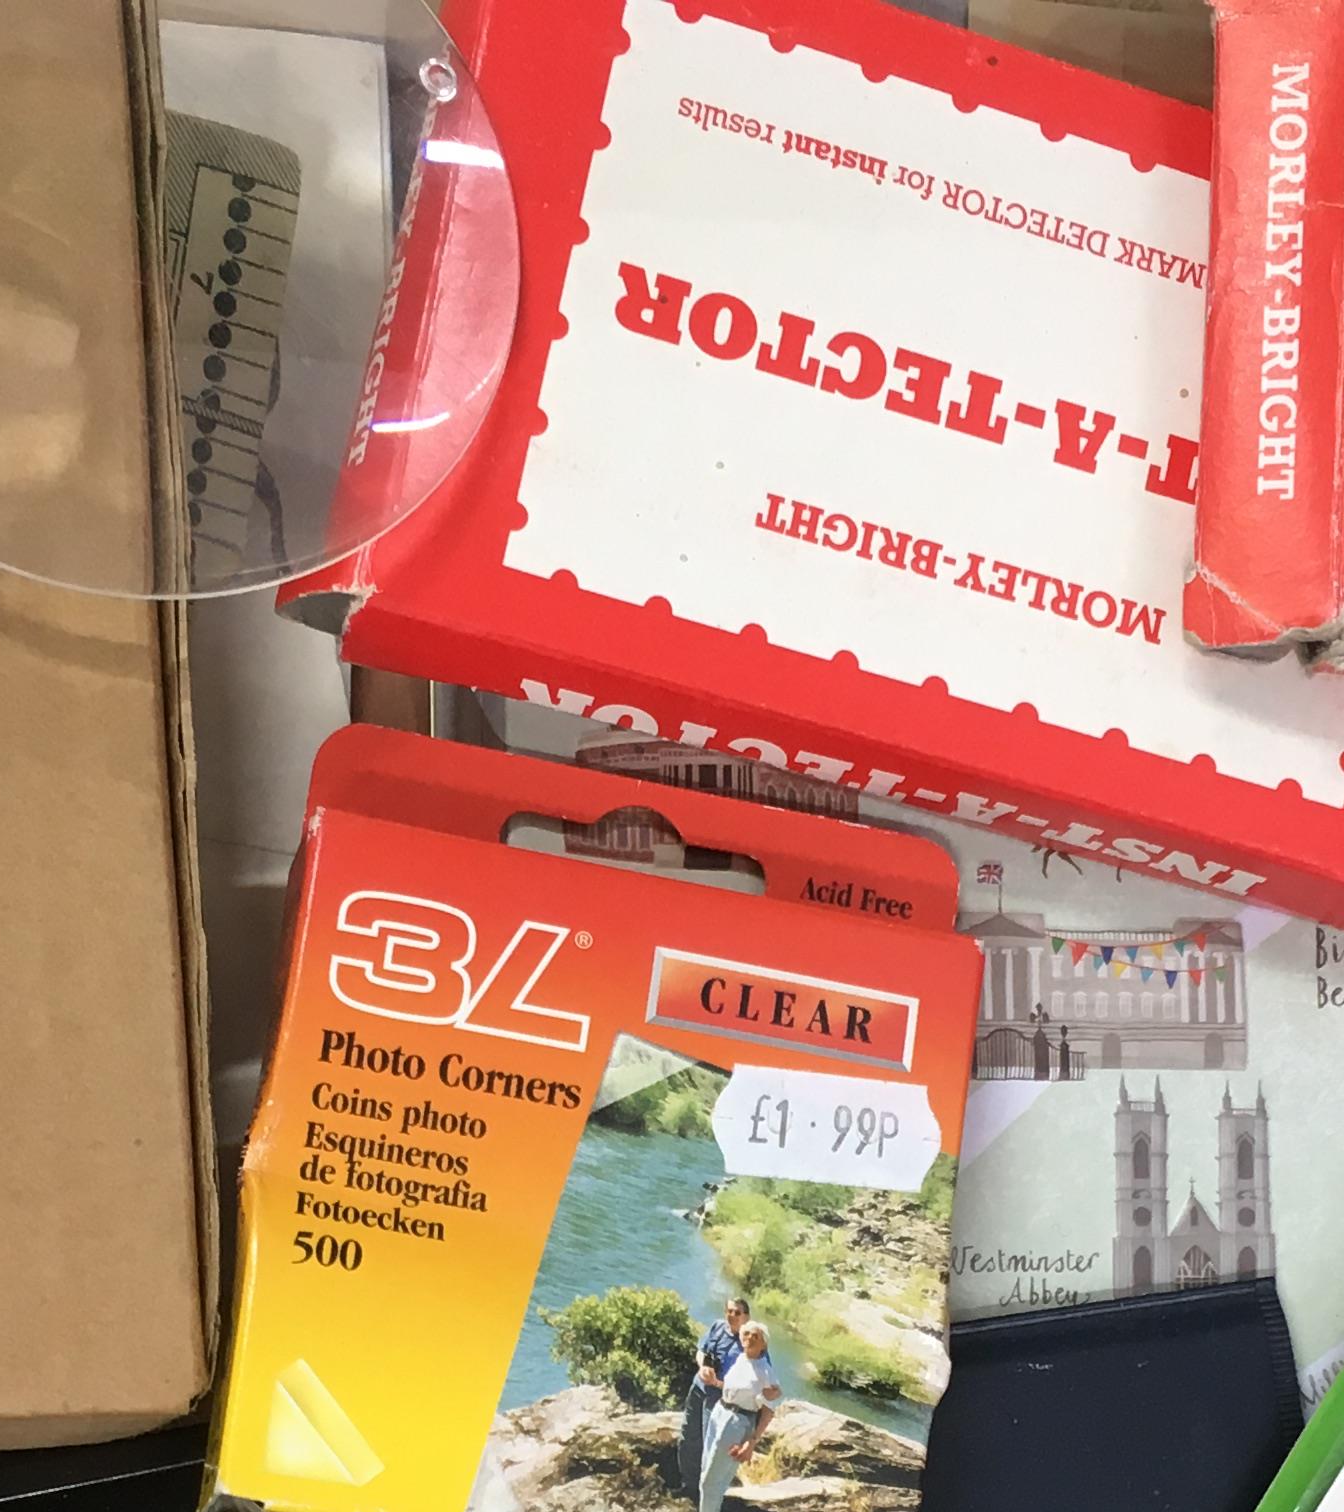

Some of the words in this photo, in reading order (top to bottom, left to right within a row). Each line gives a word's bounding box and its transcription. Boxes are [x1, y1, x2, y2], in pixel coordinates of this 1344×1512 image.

[677, 95, 776, 147] results
[781, 128, 889, 183] instant
[893, 167, 935, 204] for
[942, 180, 1108, 258] DETECTOR
[1256, 62, 1311, 500] MORLEY-BRIGHT
[756, 492, 1167, 645] MORLEY-BRIGHT
[800, 877, 853, 909] Acid
[859, 886, 913, 919] Free
[700, 977, 872, 1043] CLEAR
[318, 1029, 426, 1079] Photo
[438, 1052, 581, 1109] Corners
[311, 1083, 393, 1122] Coins
[401, 1098, 487, 1141] photo
[305, 1122, 468, 1176] Esquineros
[298, 1155, 336, 1184] de
[343, 1161, 487, 1216] fotografia
[295, 1191, 445, 1241] Fotoecken
[292, 1231, 362, 1272] 500
